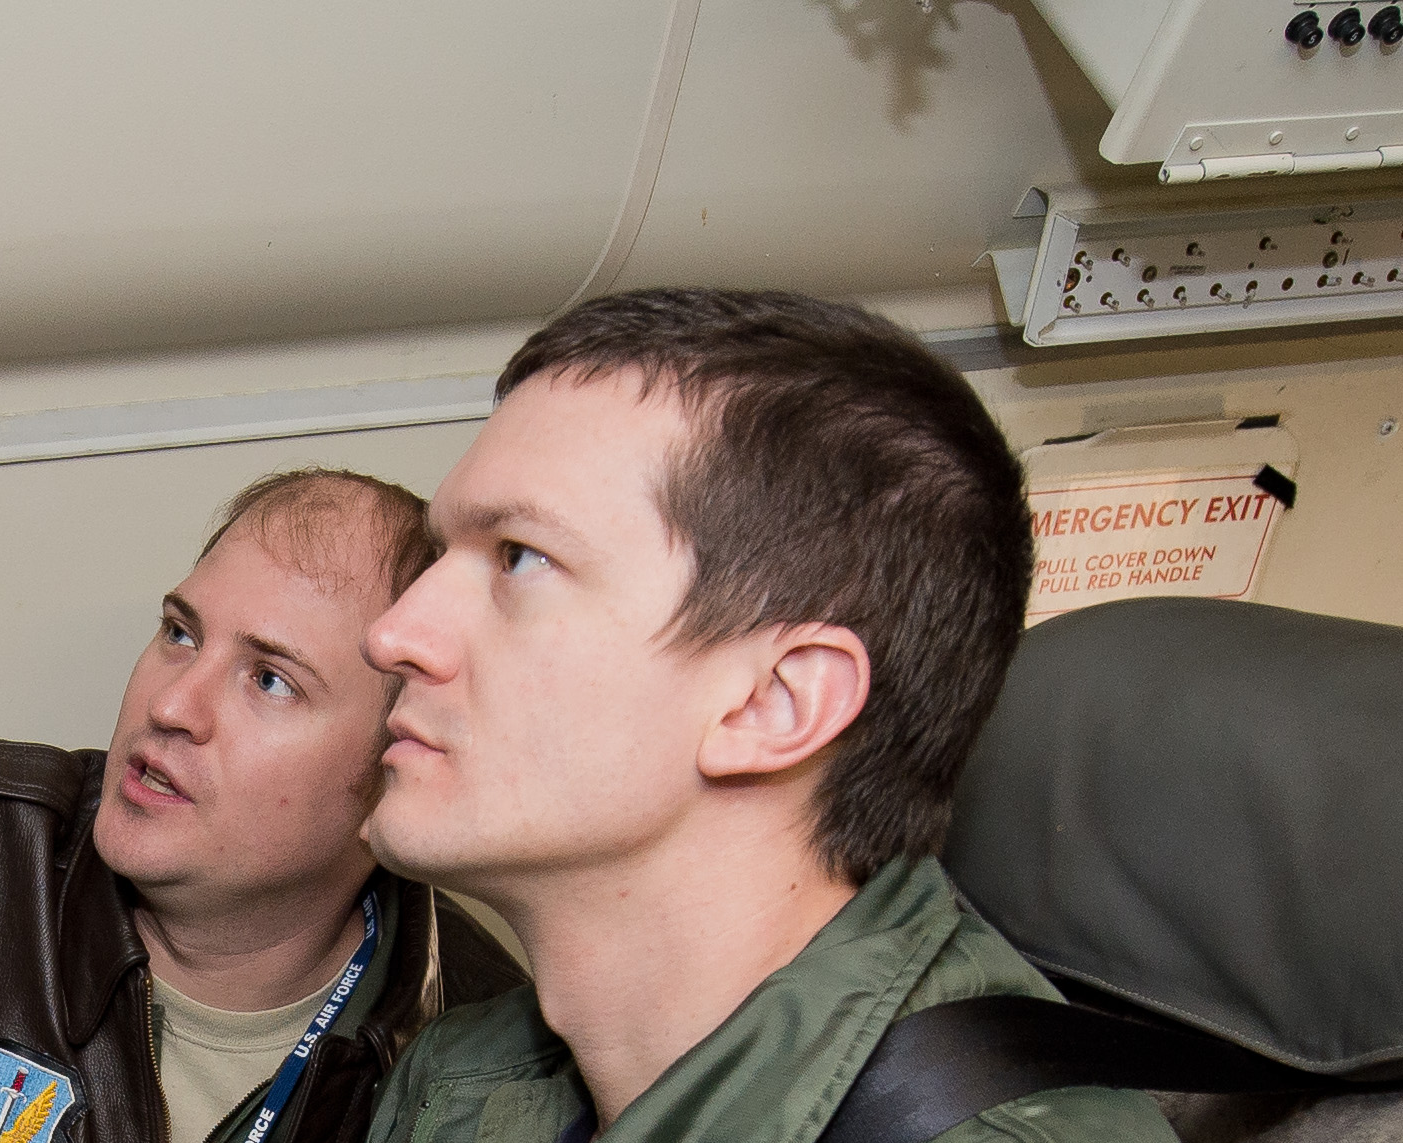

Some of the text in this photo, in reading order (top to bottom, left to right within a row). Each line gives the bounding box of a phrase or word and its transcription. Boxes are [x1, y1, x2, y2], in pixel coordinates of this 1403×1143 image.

[1031, 493, 1271, 537] MERGENCY EXIT
[1036, 545, 1216, 576] PULL COVER DOWN
[1038, 565, 1204, 595] PULL RED HANDLE
[294, 963, 364, 1058] U.S. AIR FORCE
